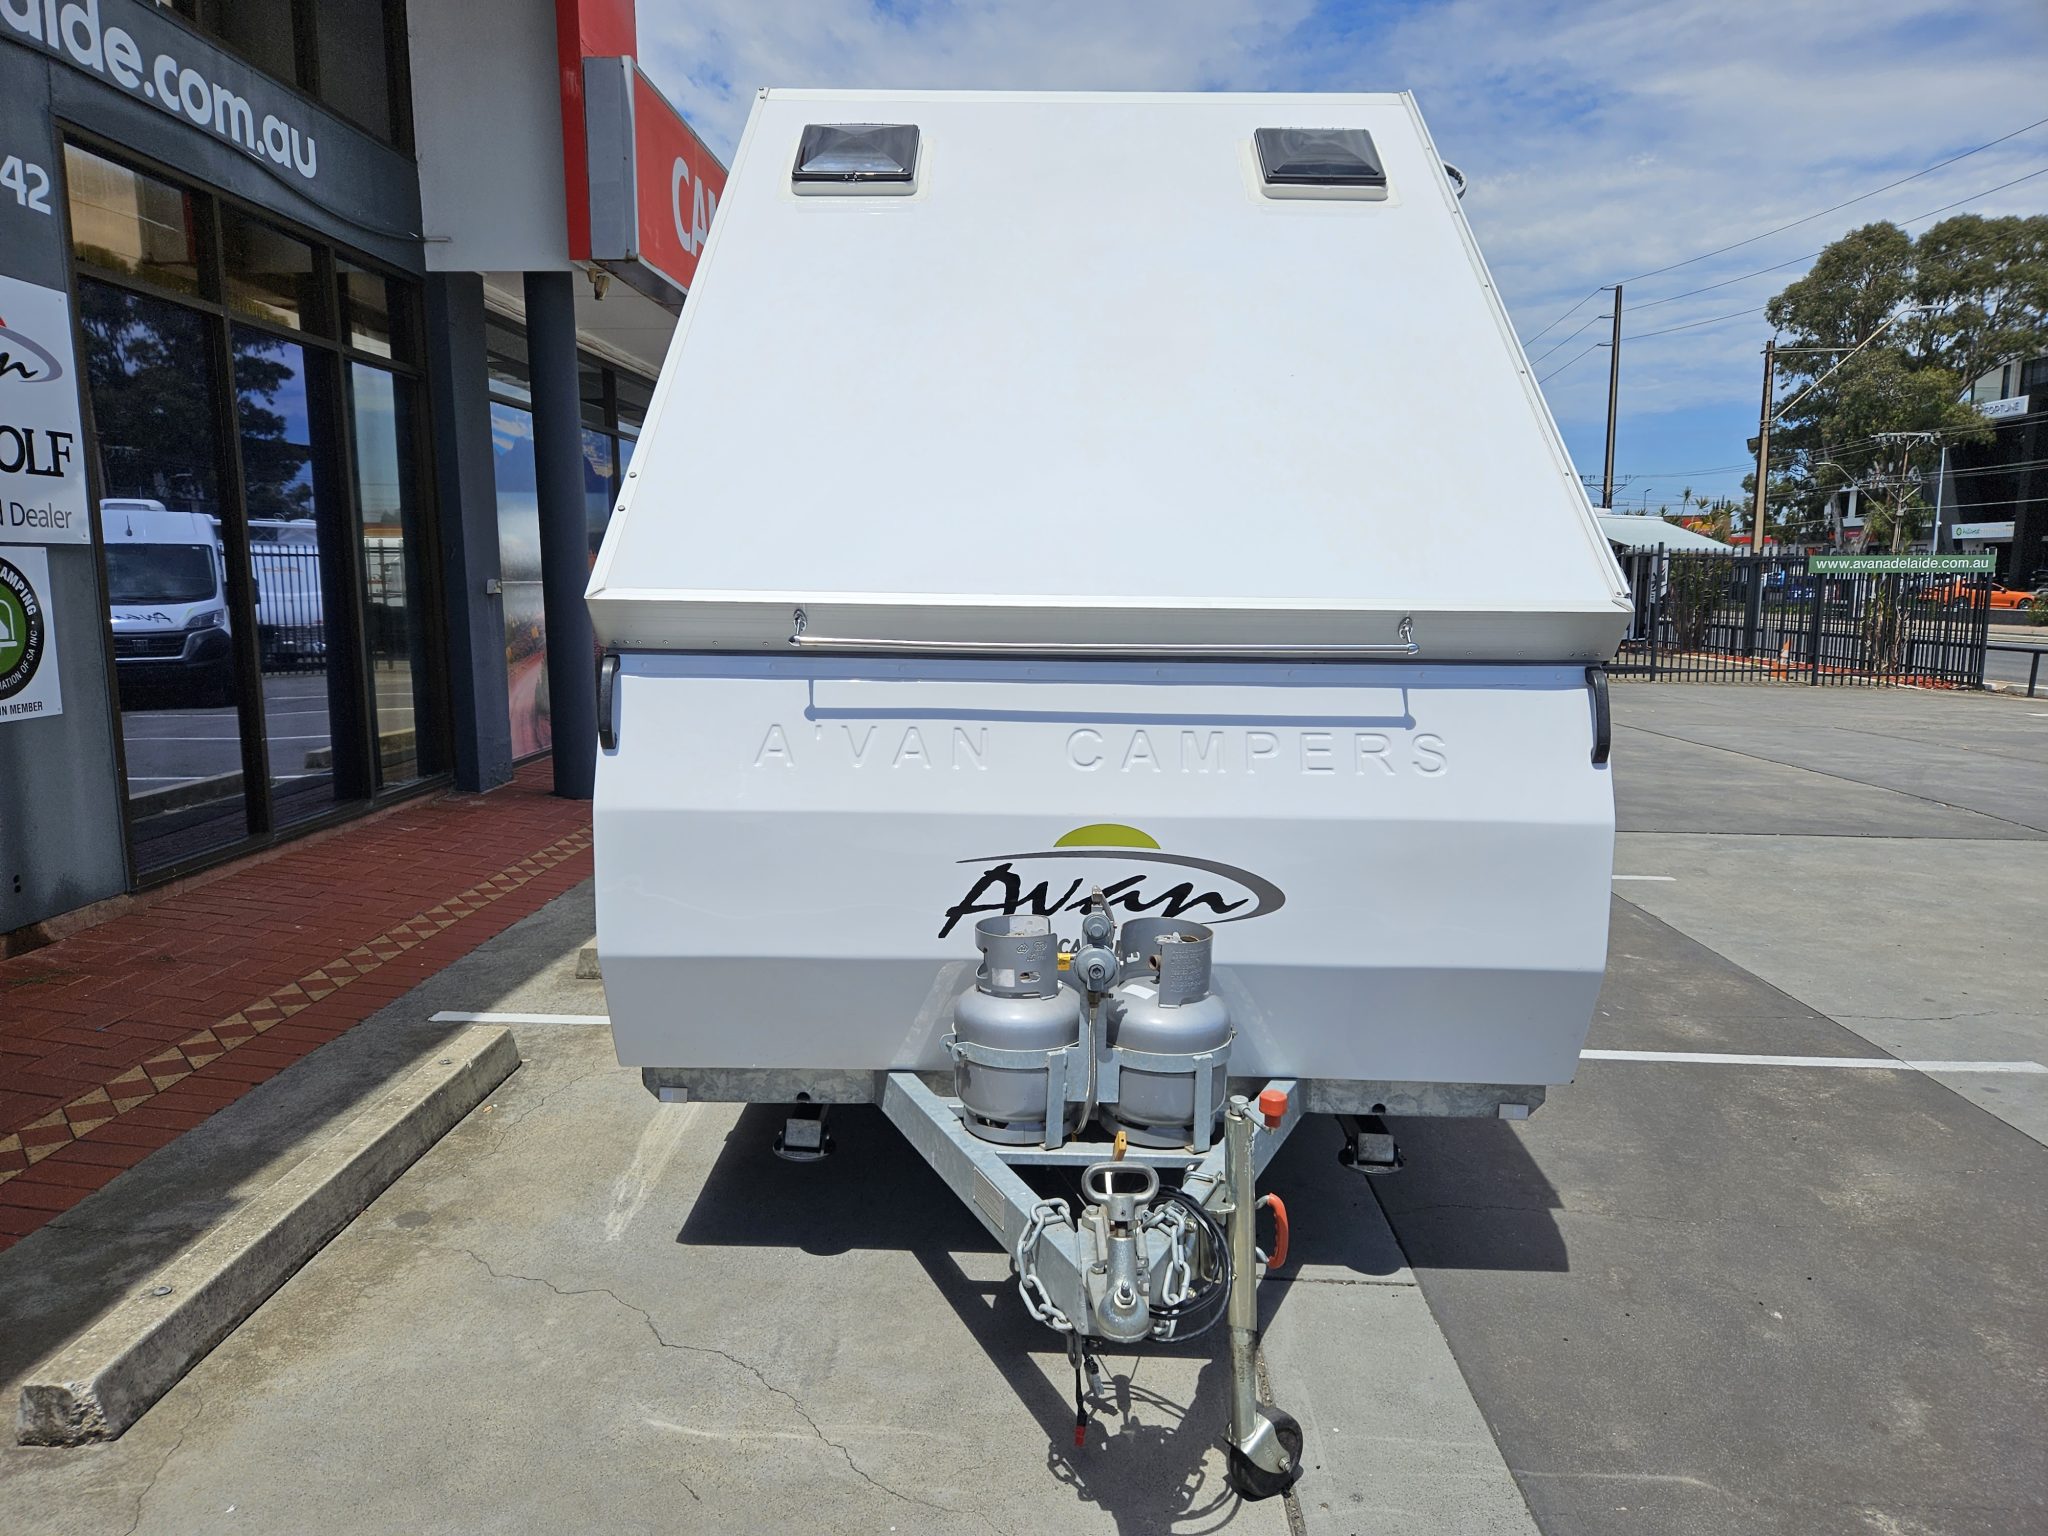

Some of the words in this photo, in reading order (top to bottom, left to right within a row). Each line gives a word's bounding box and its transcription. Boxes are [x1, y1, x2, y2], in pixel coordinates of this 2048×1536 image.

[0, 155, 51, 215] 42
[10, 501, 72, 529] Dealer
[1816, 557, 1989, 569] www.avanadelaide.com.au
[0, 565, 37, 616] AMPING
[29, 629, 38, 647] INC
[26, 648, 36, 661] SA
[20, 660, 30, 674] OF
[9, 701, 44, 715] MEMBER
[1065, 727, 1449, 779] CAMPERS
